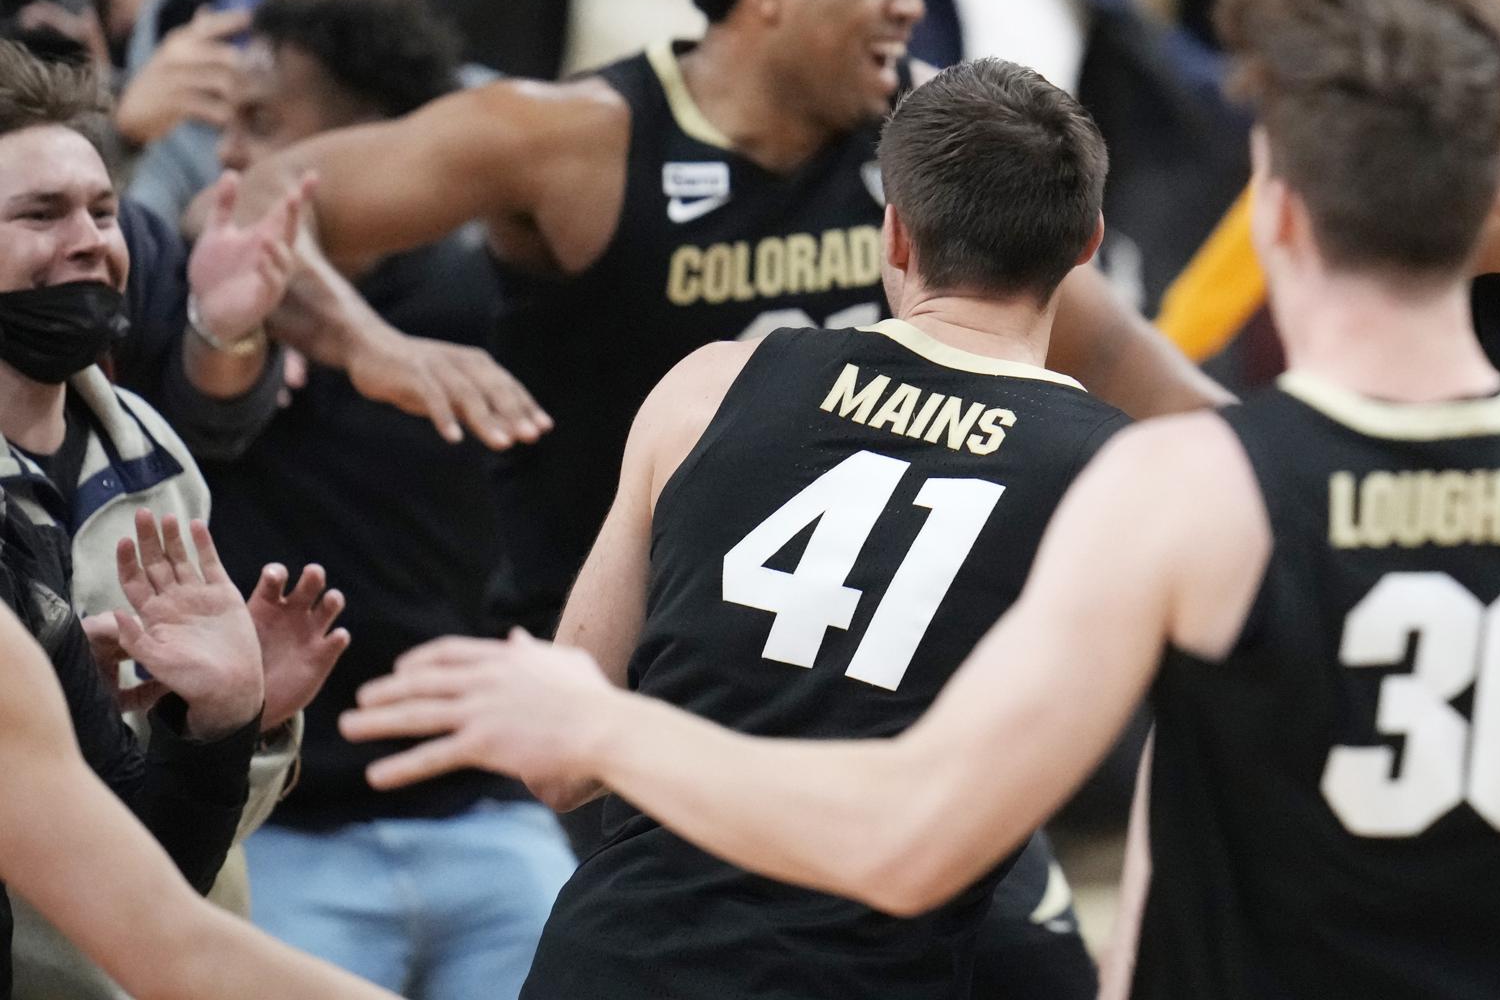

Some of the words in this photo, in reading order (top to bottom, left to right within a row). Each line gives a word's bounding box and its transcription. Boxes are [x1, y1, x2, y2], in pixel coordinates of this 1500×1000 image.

[667, 224, 884, 306] COLORAD
[819, 363, 1017, 455] MAINS
[722, 449, 1007, 692] 41
